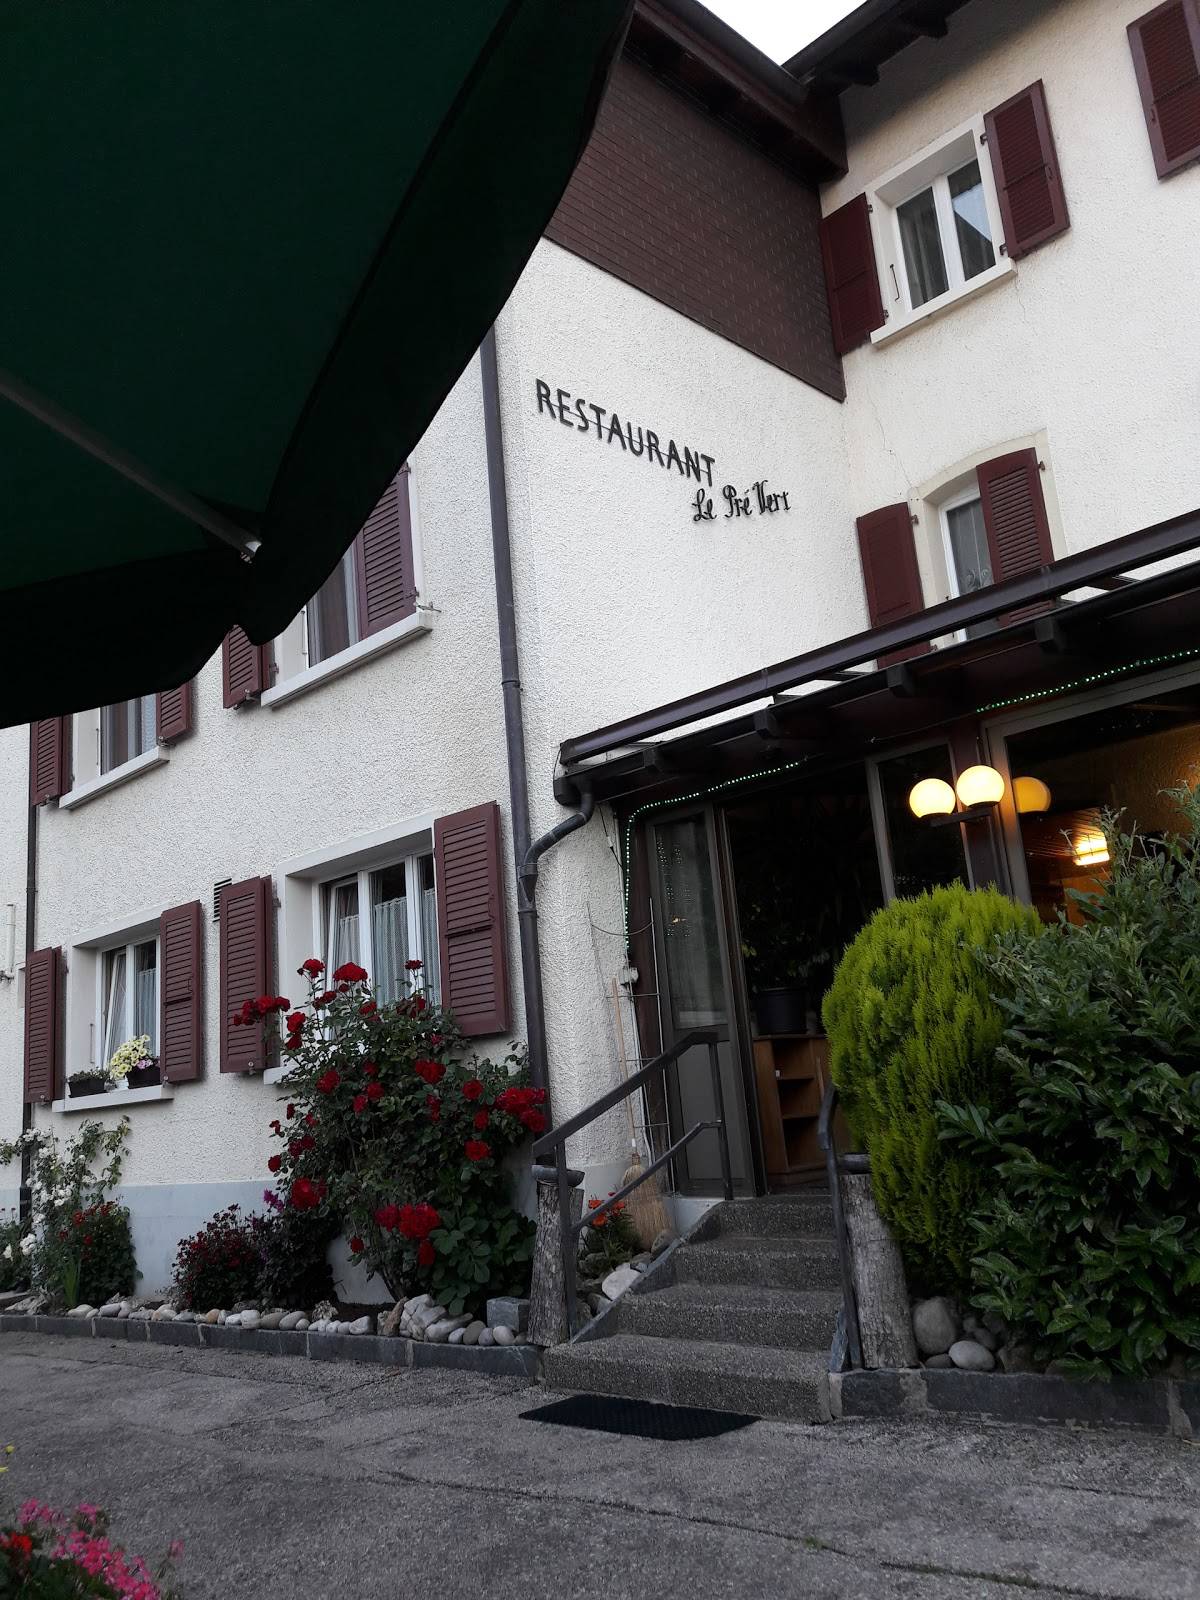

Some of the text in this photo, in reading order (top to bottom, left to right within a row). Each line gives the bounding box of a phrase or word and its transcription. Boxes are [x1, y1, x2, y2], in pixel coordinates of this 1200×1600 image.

[536, 378, 715, 487] RESTAURANT
[692, 479, 791, 522] Le Pré Vert
